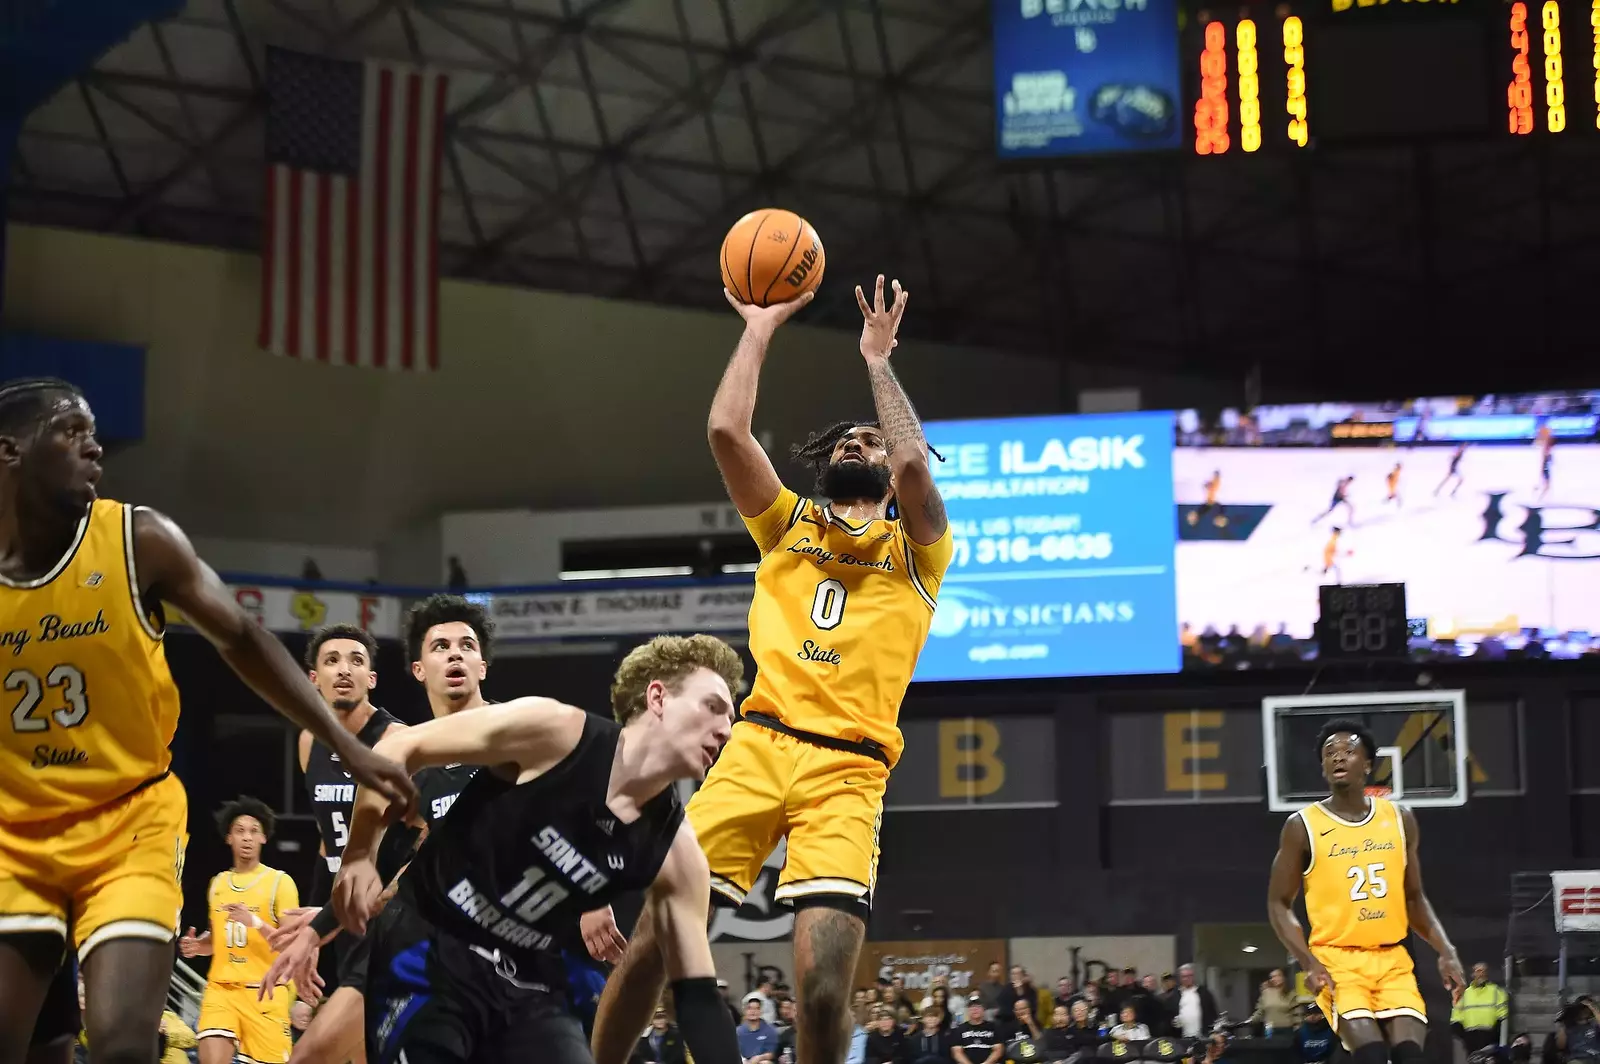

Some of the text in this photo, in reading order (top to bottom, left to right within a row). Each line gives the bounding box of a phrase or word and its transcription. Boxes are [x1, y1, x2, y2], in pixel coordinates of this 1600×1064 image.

[932, 442, 989, 477] EE
[940, 476, 1090, 500] ONSULTATION
[786, 537, 834, 565] Long
[810, 578, 848, 631] 0
[0, 609, 109, 655] ng Beach
[797, 639, 841, 665] State
[4, 663, 89, 732] 23
[31, 744, 89, 769] State
[314, 784, 355, 802] SANTA
[331, 811, 349, 847] 5
[530, 824, 610, 895] SANTA
[500, 865, 570, 924] 10
[1346, 862, 1388, 902] 25
